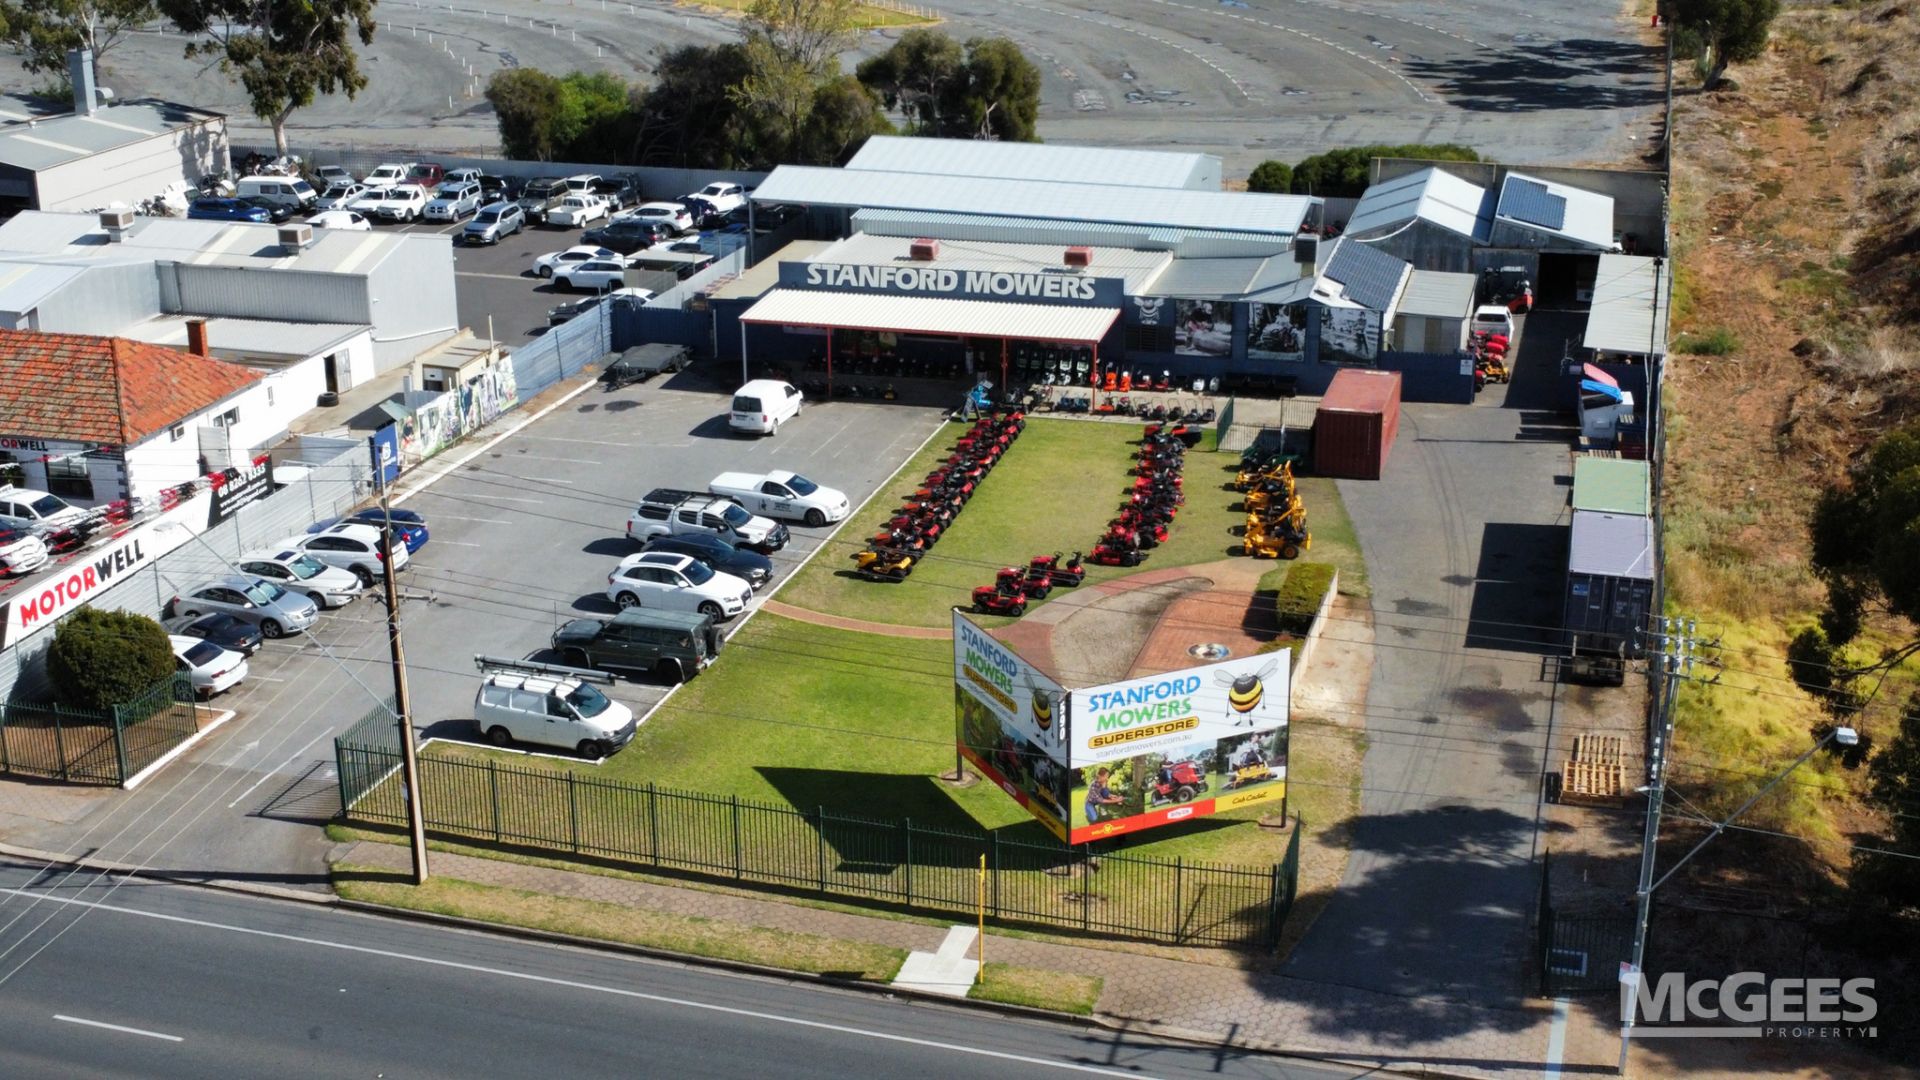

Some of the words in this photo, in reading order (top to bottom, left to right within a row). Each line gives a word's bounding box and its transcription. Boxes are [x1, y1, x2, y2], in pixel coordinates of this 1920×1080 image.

[807, 264, 959, 293] STANFORD
[965, 271, 1096, 300] MOWERS
[20, 539, 144, 628] MOTORWELL
[962, 625, 1018, 677] STANFORD
[966, 647, 1013, 695] MOWERS
[1089, 676, 1201, 712] STANFORD
[1097, 697, 1192, 732] MOWERS
[1093, 719, 1195, 747] SUPERSTORE
